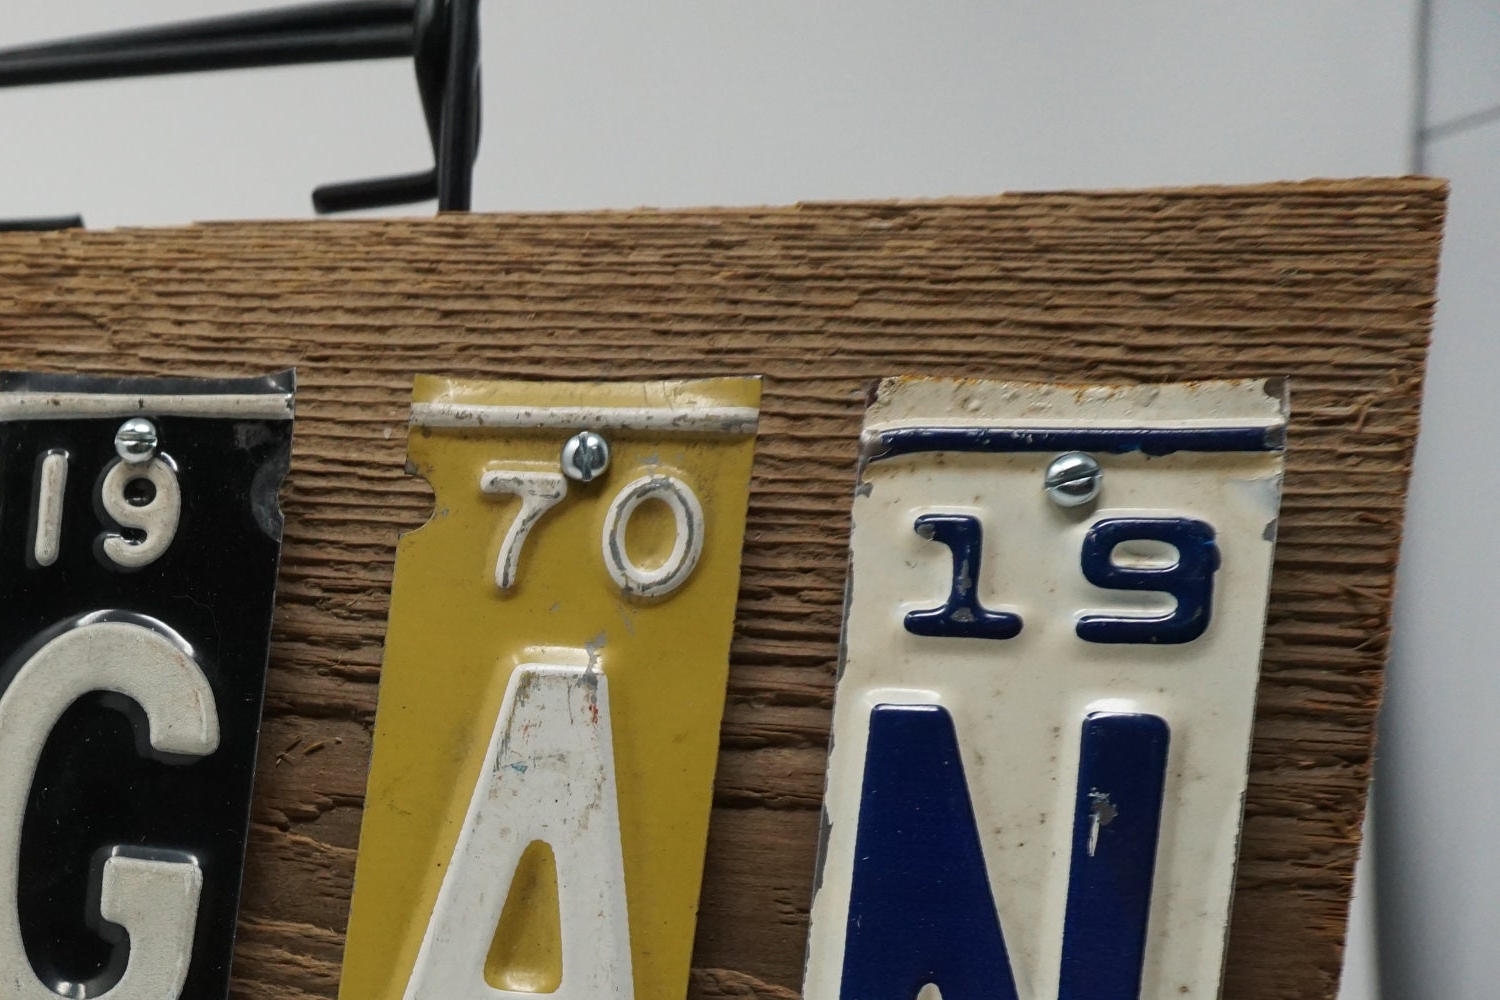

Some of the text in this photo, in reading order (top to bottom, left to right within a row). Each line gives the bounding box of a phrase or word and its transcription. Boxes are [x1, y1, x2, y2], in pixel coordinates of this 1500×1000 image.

[35, 449, 182, 568] 19
[479, 468, 705, 597] 70
[903, 511, 1221, 645] 19
